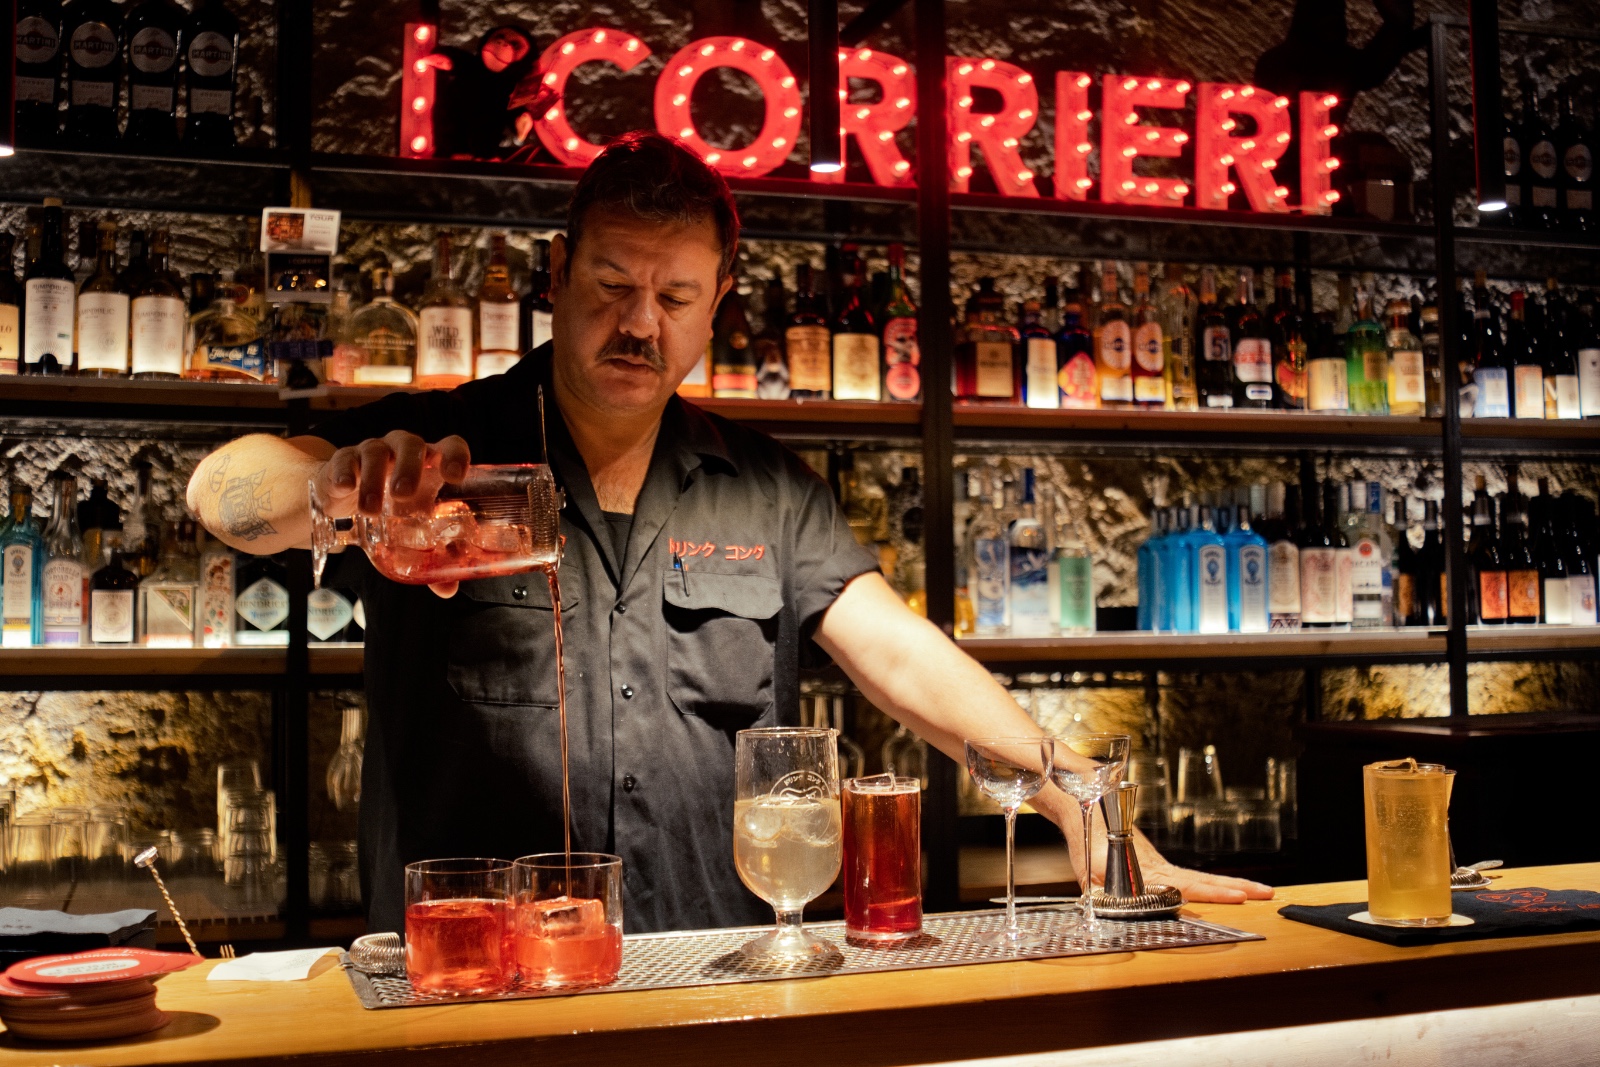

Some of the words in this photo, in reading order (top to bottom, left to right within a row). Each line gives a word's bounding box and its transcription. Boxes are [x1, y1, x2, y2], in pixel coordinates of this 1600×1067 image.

[73, 40, 115, 52] MARTINI
[133, 45, 174, 57] MARTINI
[191, 49, 231, 61] MARTINI
[533, 27, 1334, 216] CORRIERI
[432, 325, 459, 339] WILD
